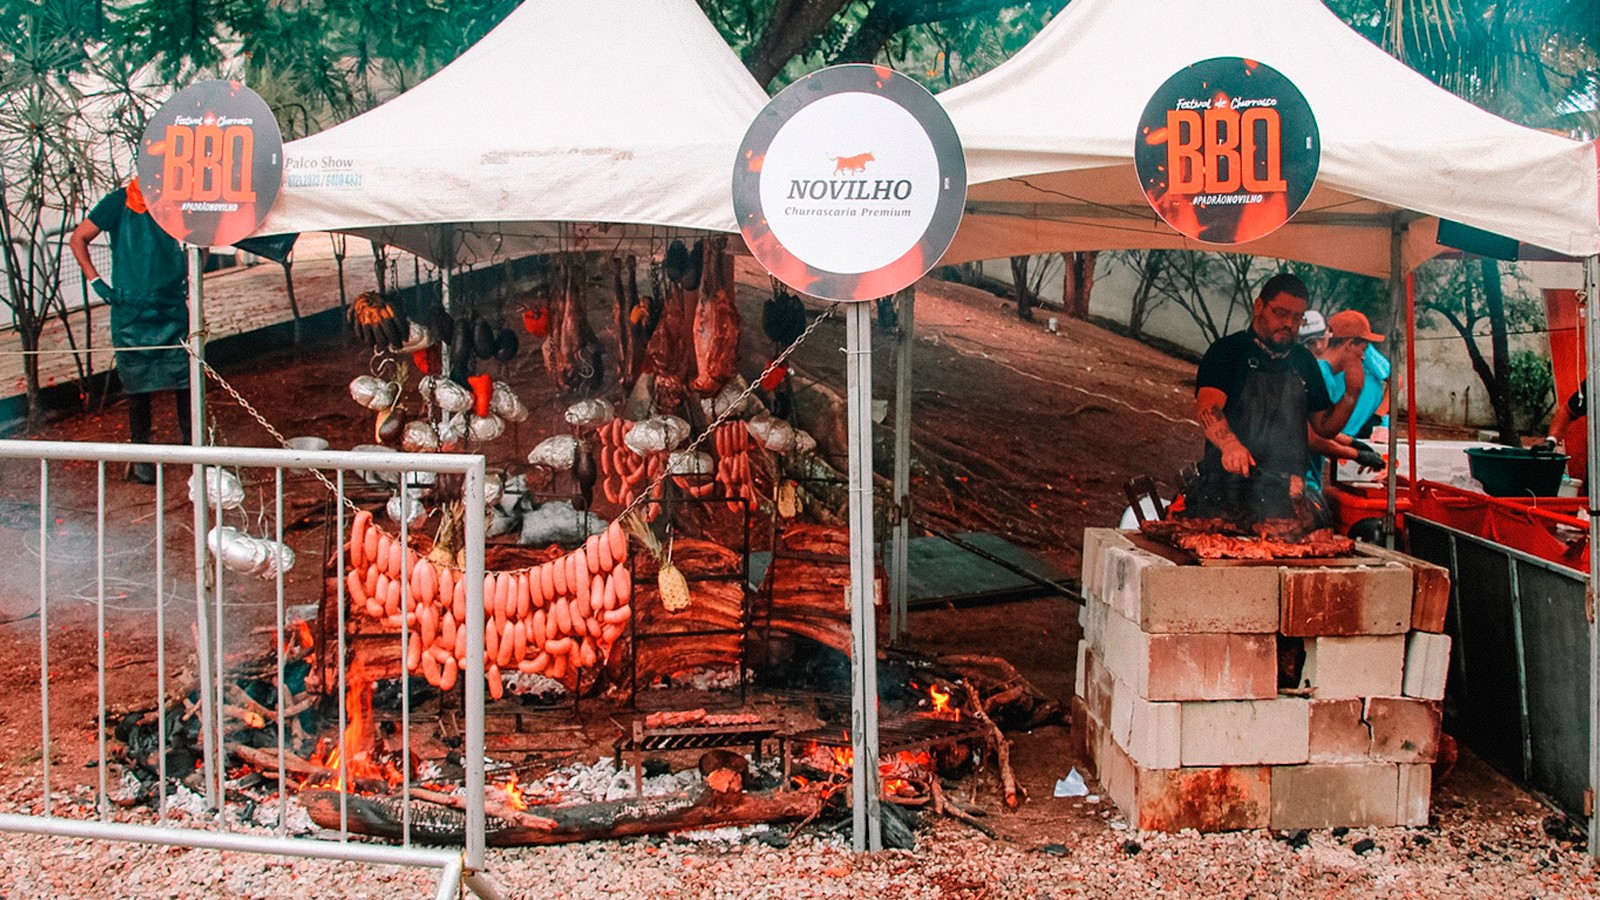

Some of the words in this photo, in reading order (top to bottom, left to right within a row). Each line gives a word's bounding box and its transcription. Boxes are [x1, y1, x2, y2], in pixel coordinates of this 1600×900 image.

[1176, 98, 1212, 111] Festival
[1214, 98, 1227, 108] de
[1230, 97, 1277, 109] Churrasco
[174, 115, 202, 126] Festival
[216, 115, 253, 127] Churrasco
[1167, 107, 1287, 195] BBQ
[161, 125, 257, 202] BBQ
[286, 157, 318, 168] Palco
[321, 156, 354, 168] Show
[786, 179, 912, 200] NOVILHO
[1193, 194, 1263, 205] #PADRÃONOVILHO
[784, 206, 857, 217] Churrascaria
[861, 207, 911, 217] Premium
